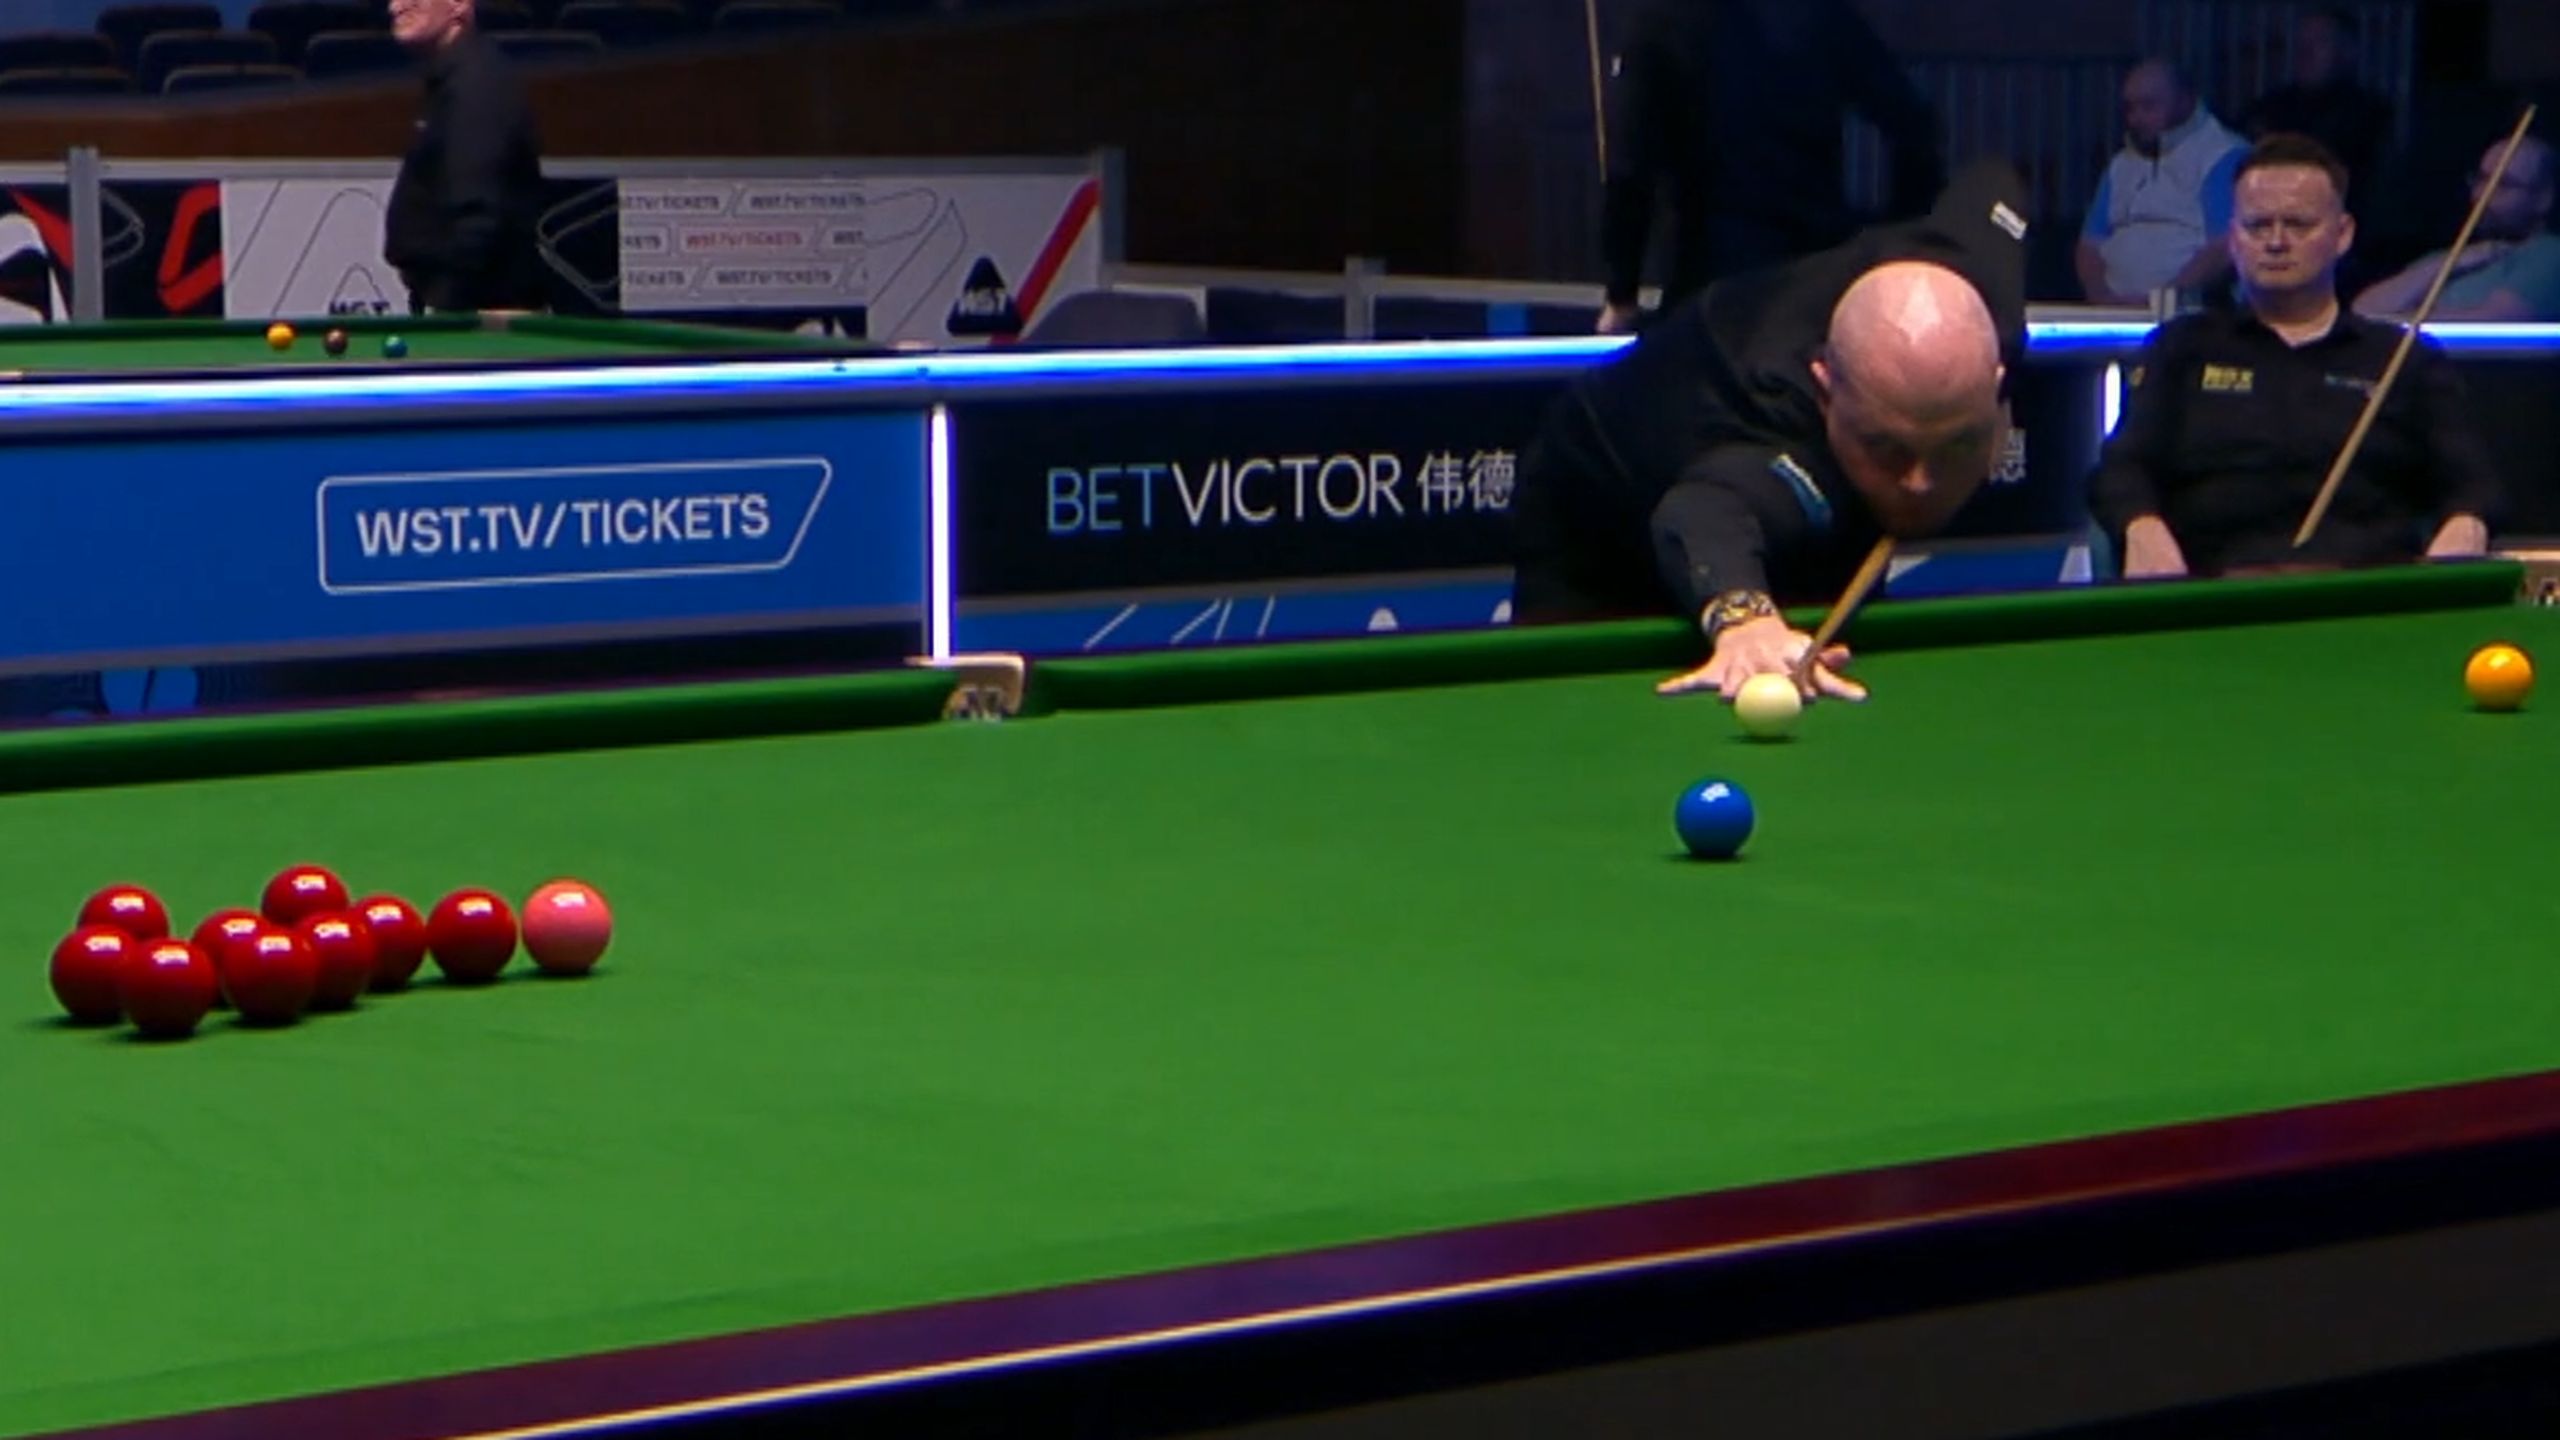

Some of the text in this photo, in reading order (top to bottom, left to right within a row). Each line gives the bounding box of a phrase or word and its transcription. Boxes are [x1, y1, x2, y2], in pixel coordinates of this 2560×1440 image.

[355, 493, 772, 558] WST.TV/TICKETS
[1045, 449, 1517, 534] BETVICTOR 伟德
